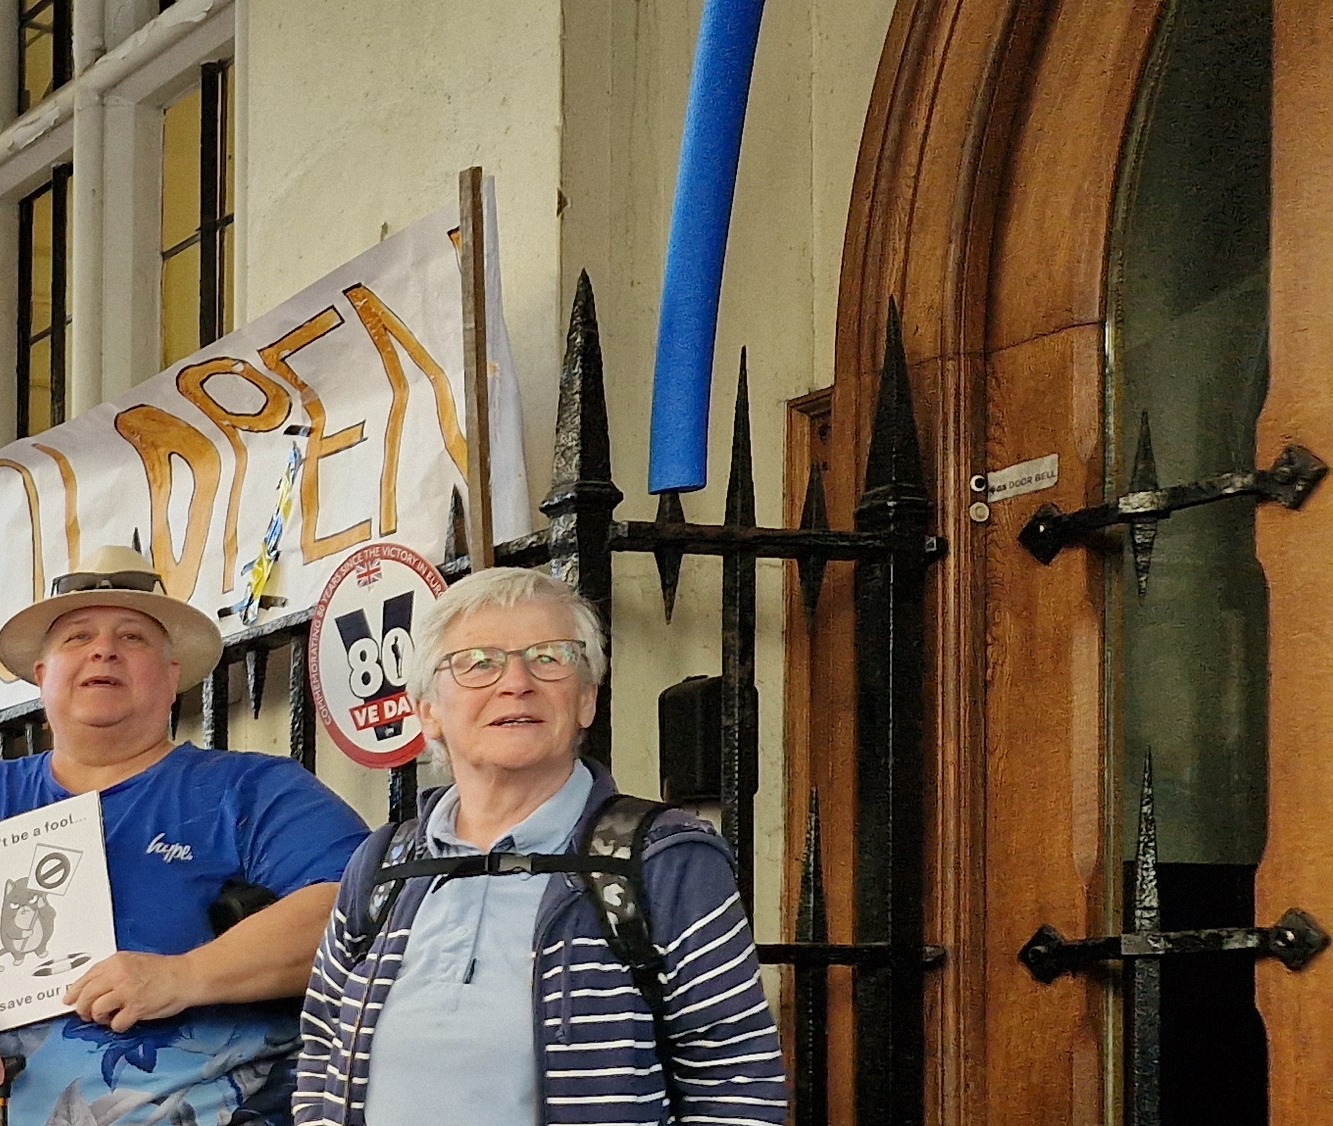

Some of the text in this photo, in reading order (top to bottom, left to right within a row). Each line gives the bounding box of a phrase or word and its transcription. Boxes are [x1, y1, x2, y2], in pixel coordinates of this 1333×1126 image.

[1009, 477, 1032, 489] DOOR
[1035, 470, 1055, 482] BELL
[321, 572, 342, 603] YEARS
[340, 553, 364, 575] SINCE
[363, 546, 381, 559] THE
[382, 546, 418, 565] VICTORY
[418, 561, 428, 576] IN
[426, 570, 443, 597] EUR
[347, 626, 415, 699] 80
[353, 695, 411, 727] VE DA
[11, 830, 29, 845] be
[33, 827, 42, 837] a
[44, 813, 87, 834] fool...
[36, 984, 62, 1001] our
